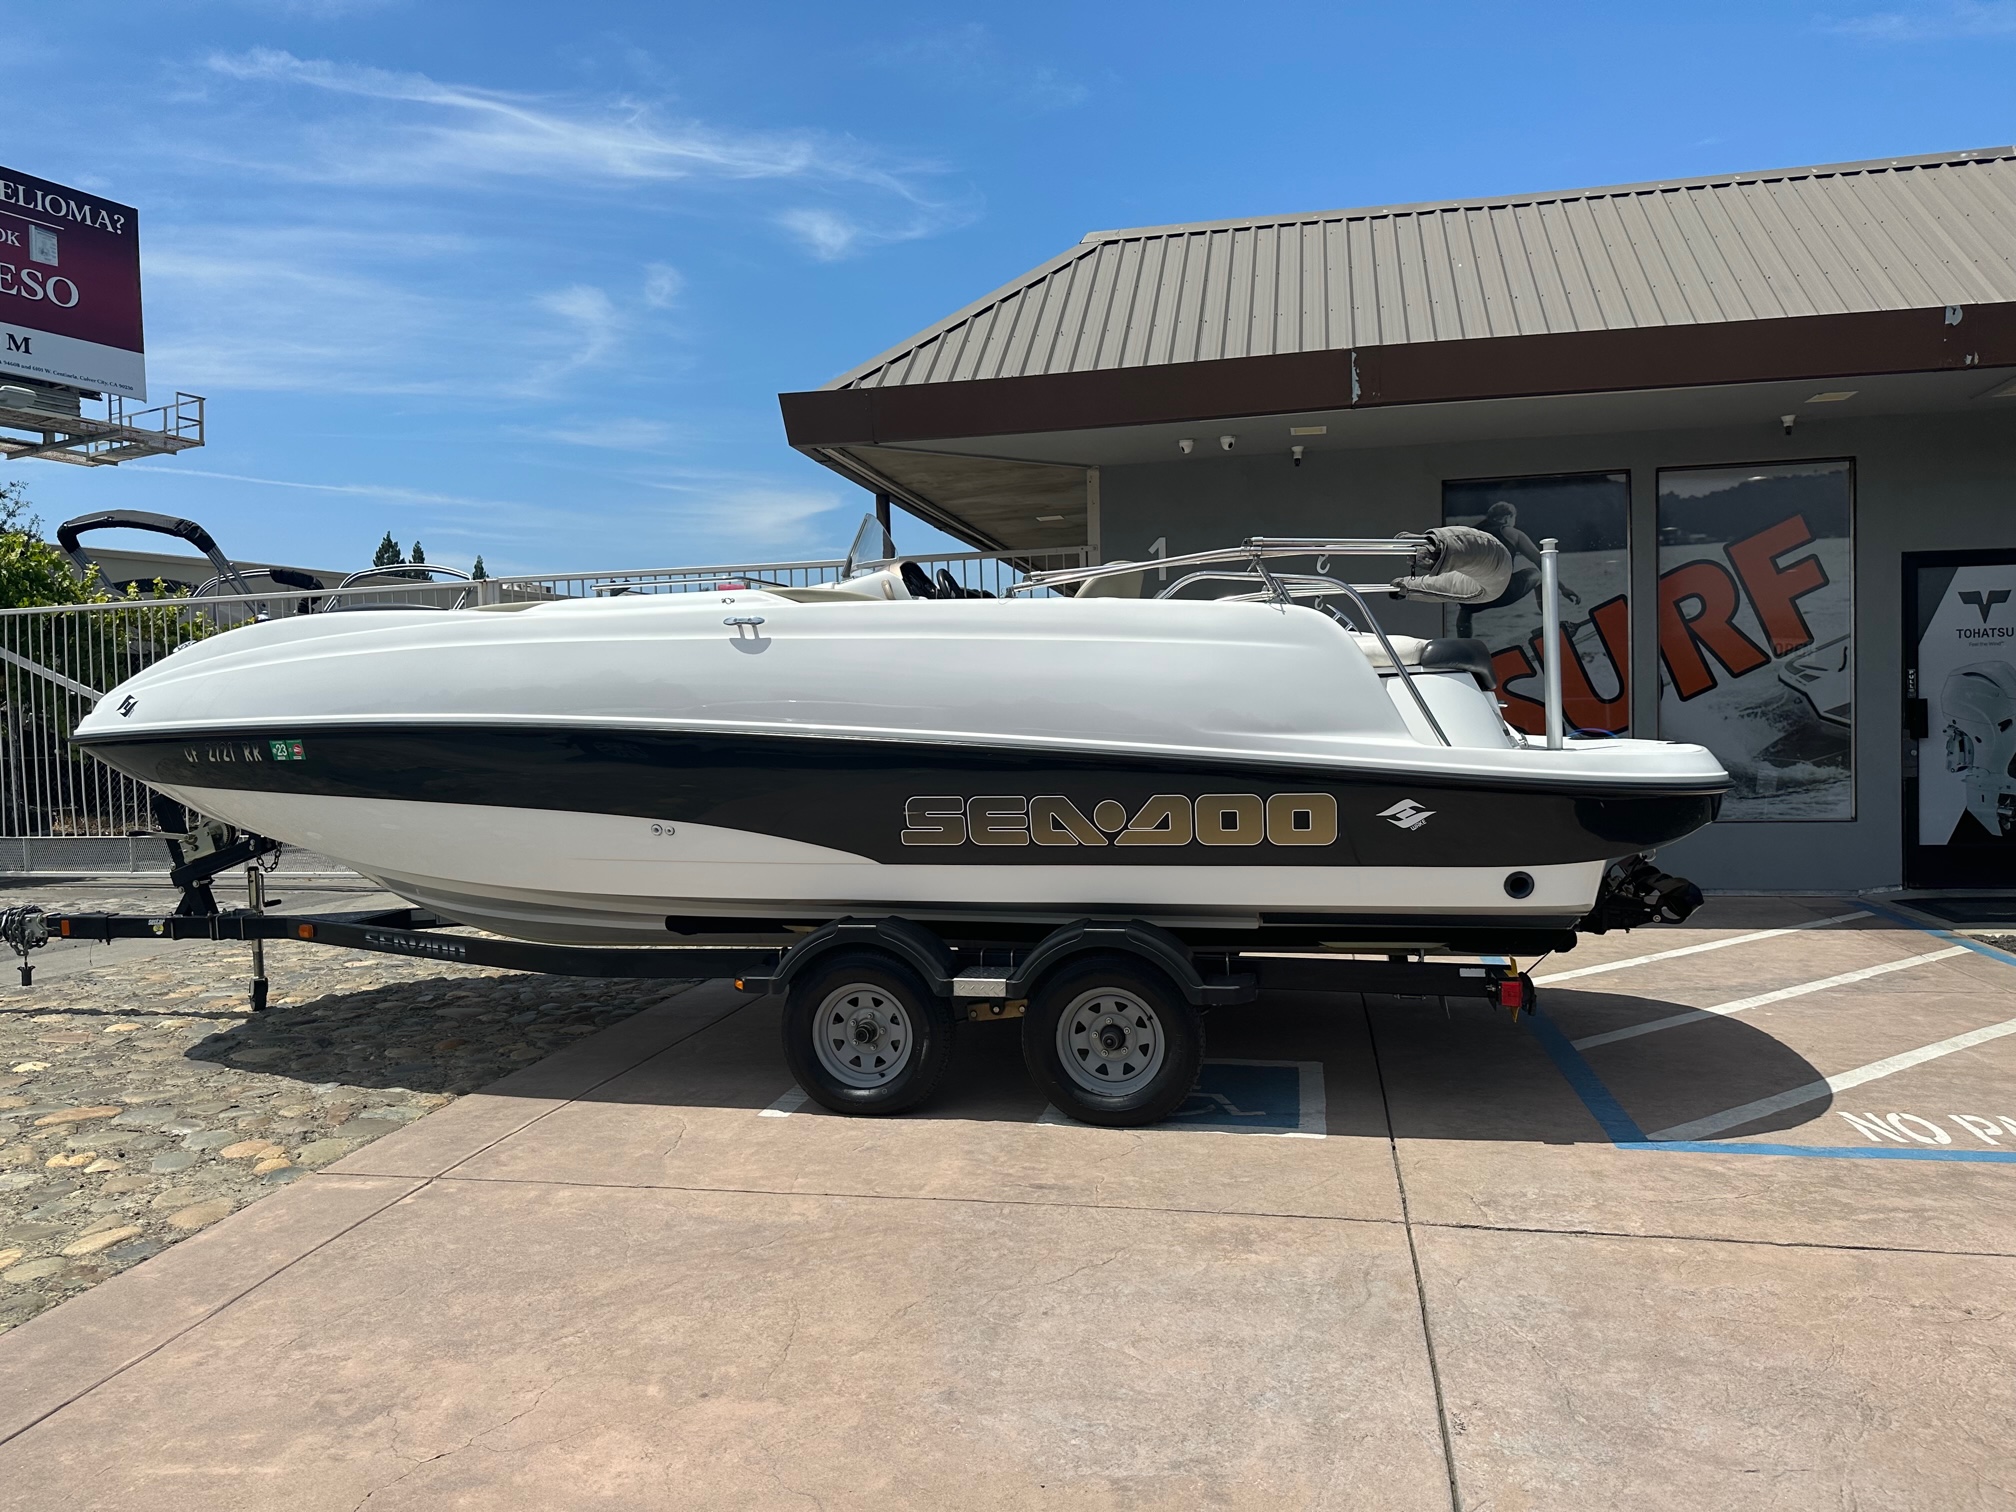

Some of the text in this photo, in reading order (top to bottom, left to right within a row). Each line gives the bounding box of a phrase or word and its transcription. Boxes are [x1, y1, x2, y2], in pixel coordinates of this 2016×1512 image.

[1491, 514, 1829, 736] SURF
[1955, 627, 2015, 639] TOHATSU
[275, 744, 288, 756] 23
[1836, 1111, 1952, 1145] NO
